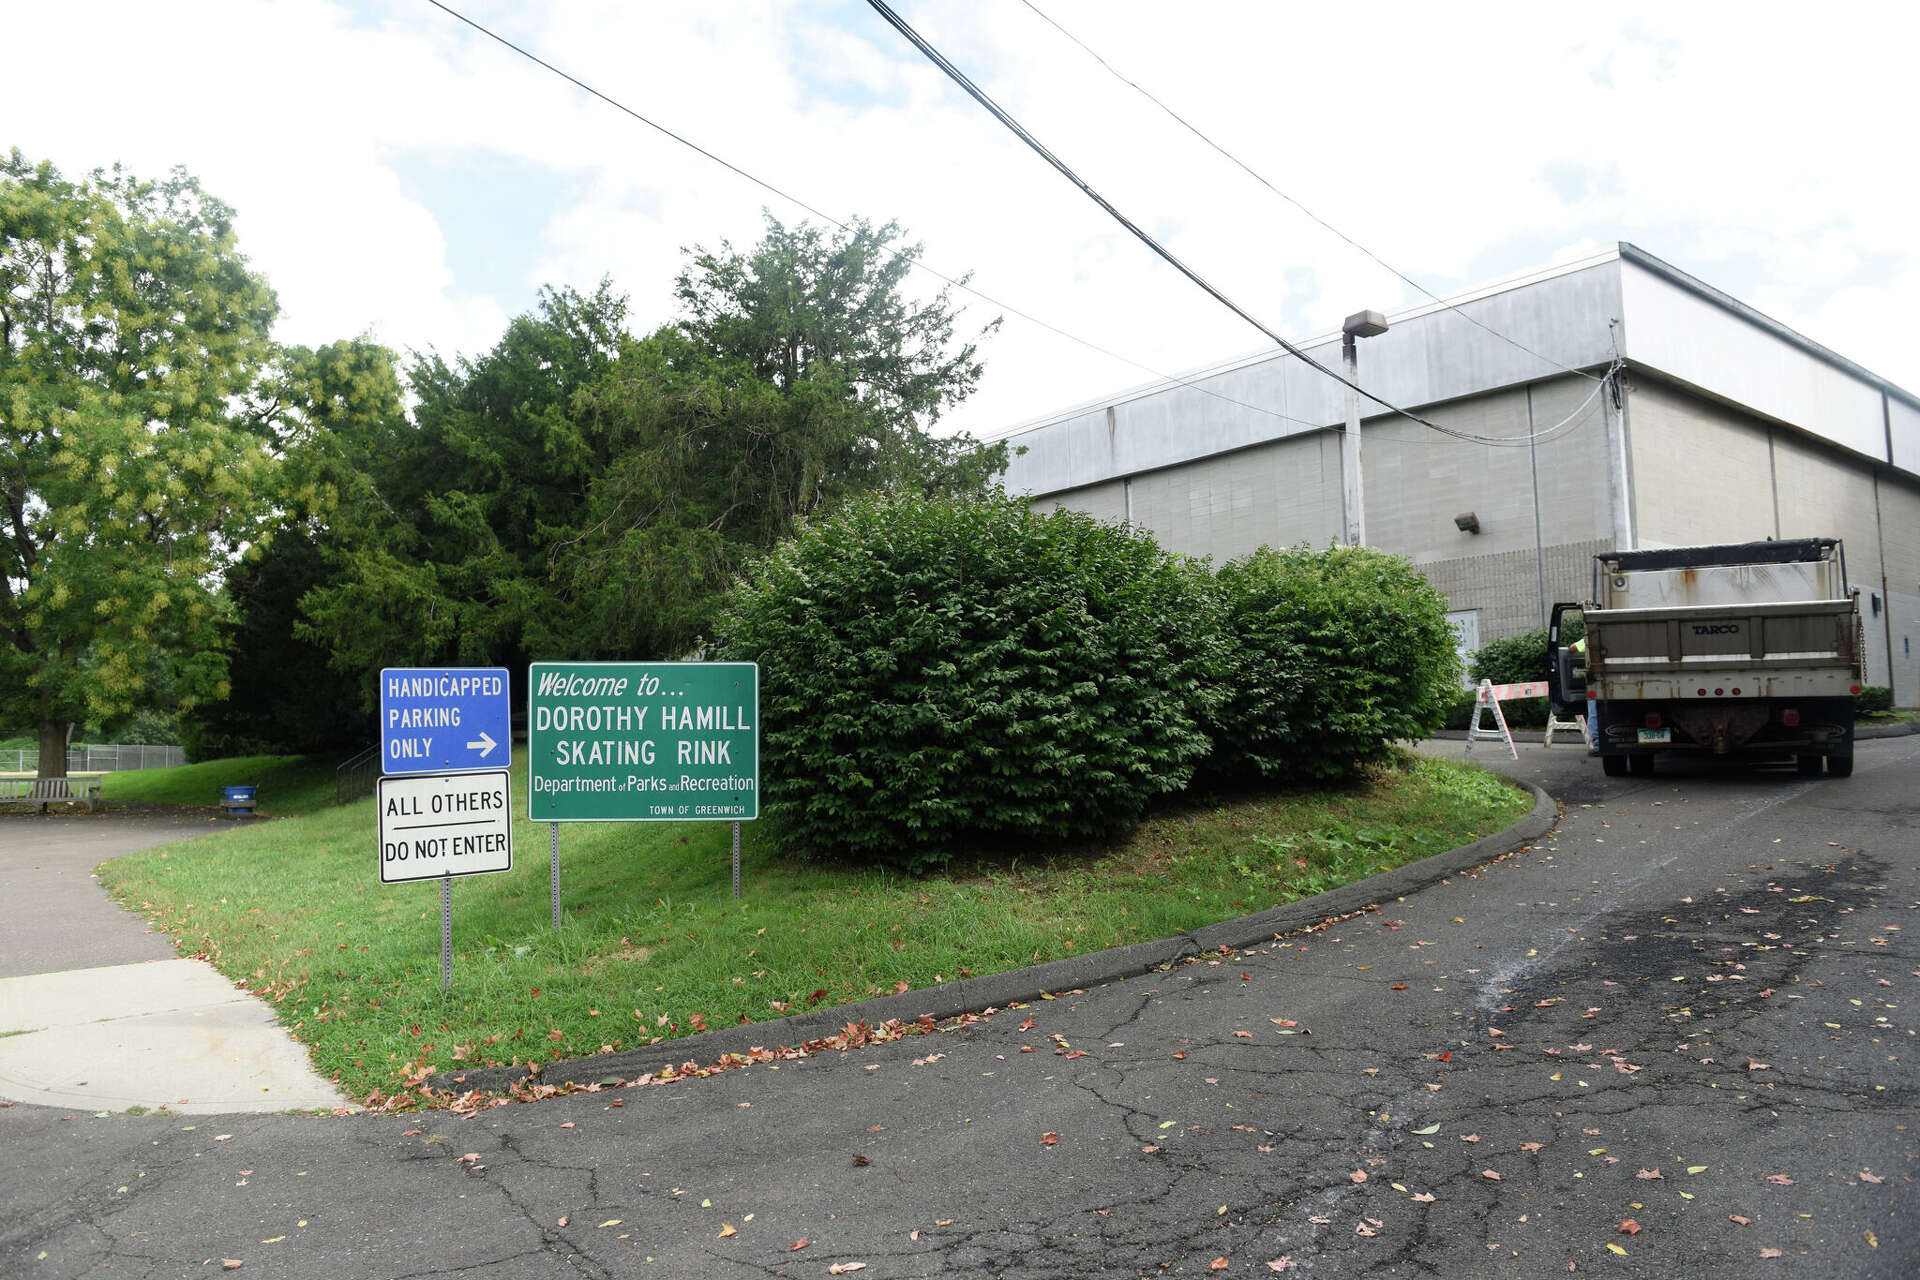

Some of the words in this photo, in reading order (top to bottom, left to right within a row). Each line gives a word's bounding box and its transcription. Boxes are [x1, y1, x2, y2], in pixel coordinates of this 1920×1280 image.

[1692, 624, 1740, 635] TARCO
[388, 677, 502, 698] HANDICAPPED
[537, 672, 628, 696] Welcome
[388, 707, 461, 729] PARKING
[536, 706, 648, 731] DOROTHY
[661, 706, 751, 731] HAMILL
[390, 738, 432, 759] ONLY
[556, 740, 656, 765] SKATING
[677, 740, 732, 765] RINK
[534, 775, 617, 796] Department
[618, 783, 627, 792] of
[627, 775, 667, 792] Parks
[668, 783, 680, 791] and
[680, 774, 754, 791] Recreation
[386, 796, 423, 816] ALL
[431, 790, 503, 813] OTHERS
[649, 805, 674, 815] TOWN
[678, 805, 689, 815] OF
[695, 805, 745, 815] GREENWICH
[385, 841, 409, 861] DO
[415, 838, 448, 859] NOT
[453, 833, 506, 856] ENTER
